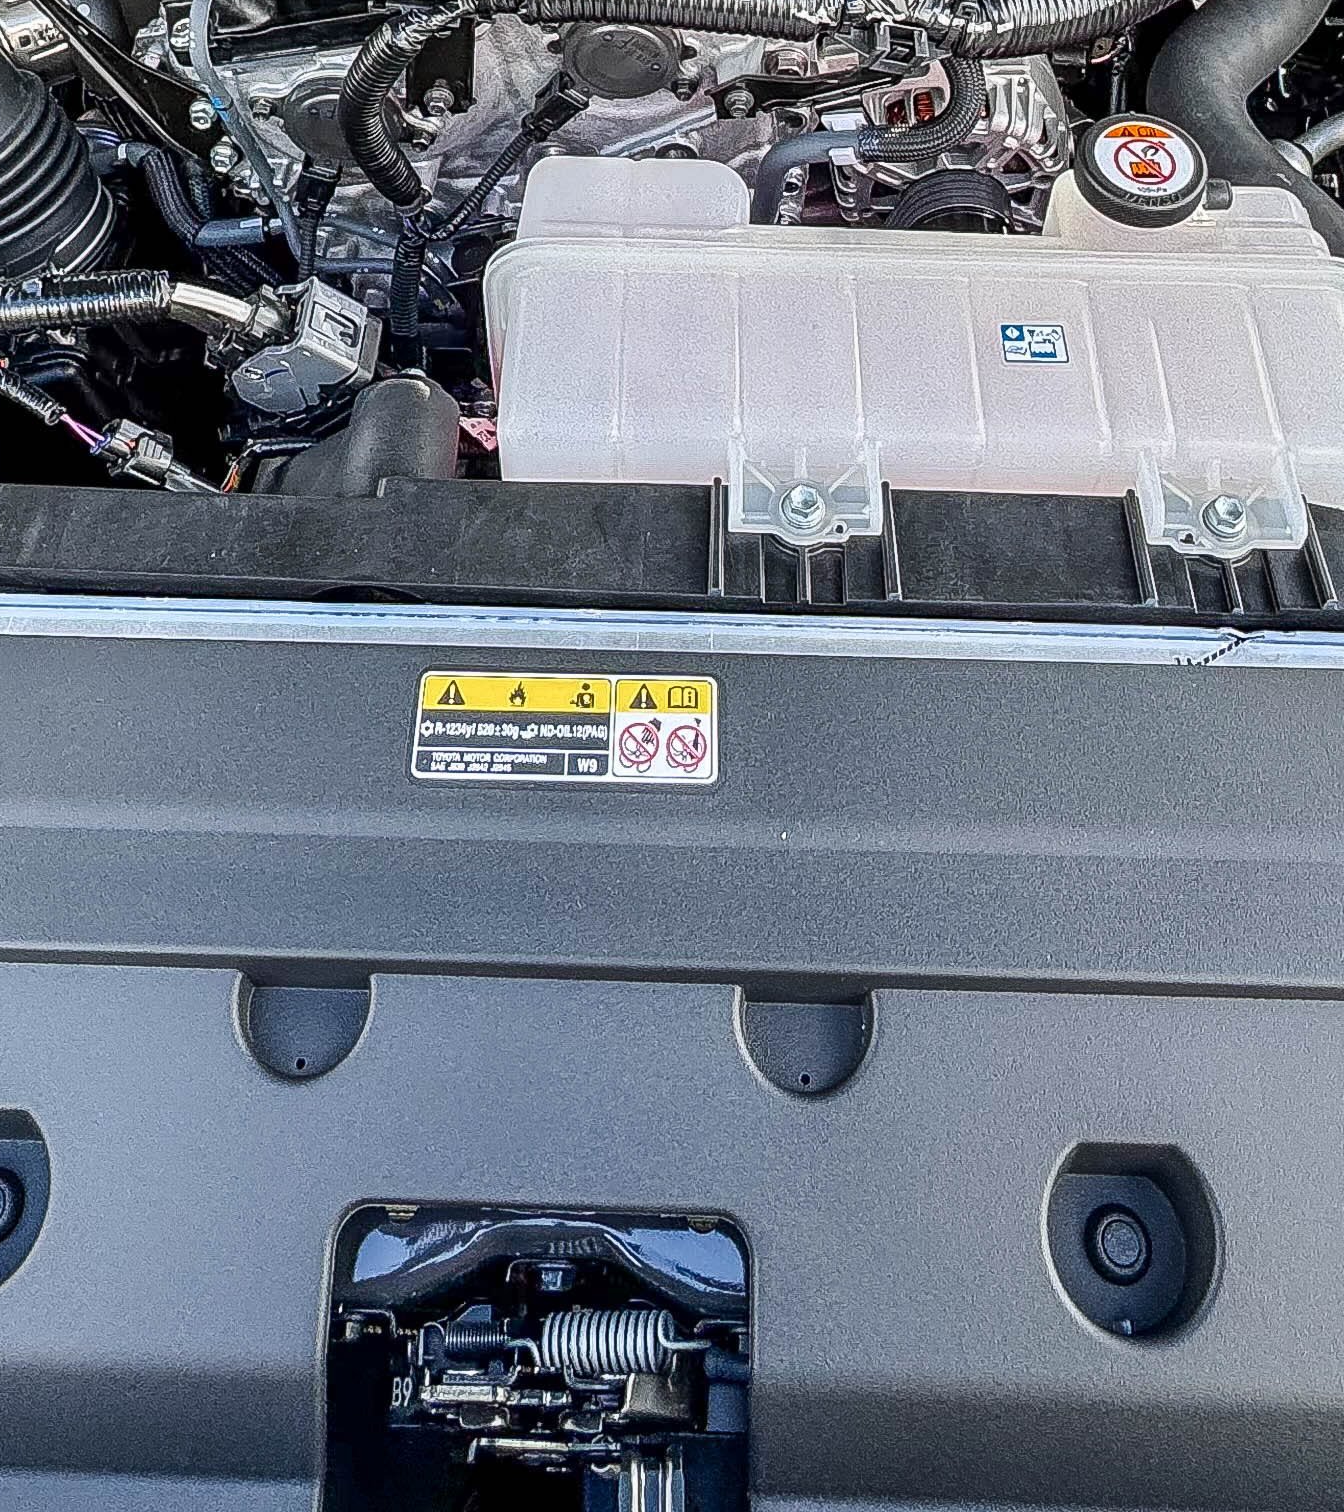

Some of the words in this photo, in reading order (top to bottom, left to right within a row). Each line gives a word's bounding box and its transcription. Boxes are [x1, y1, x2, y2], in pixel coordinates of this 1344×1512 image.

[431, 752, 461, 762] TOYOTA
[462, 752, 491, 763] MOTOR
[492, 752, 547, 764] CORPORATION
[577, 757, 598, 773] W9
[391, 1376, 413, 1407] B9
